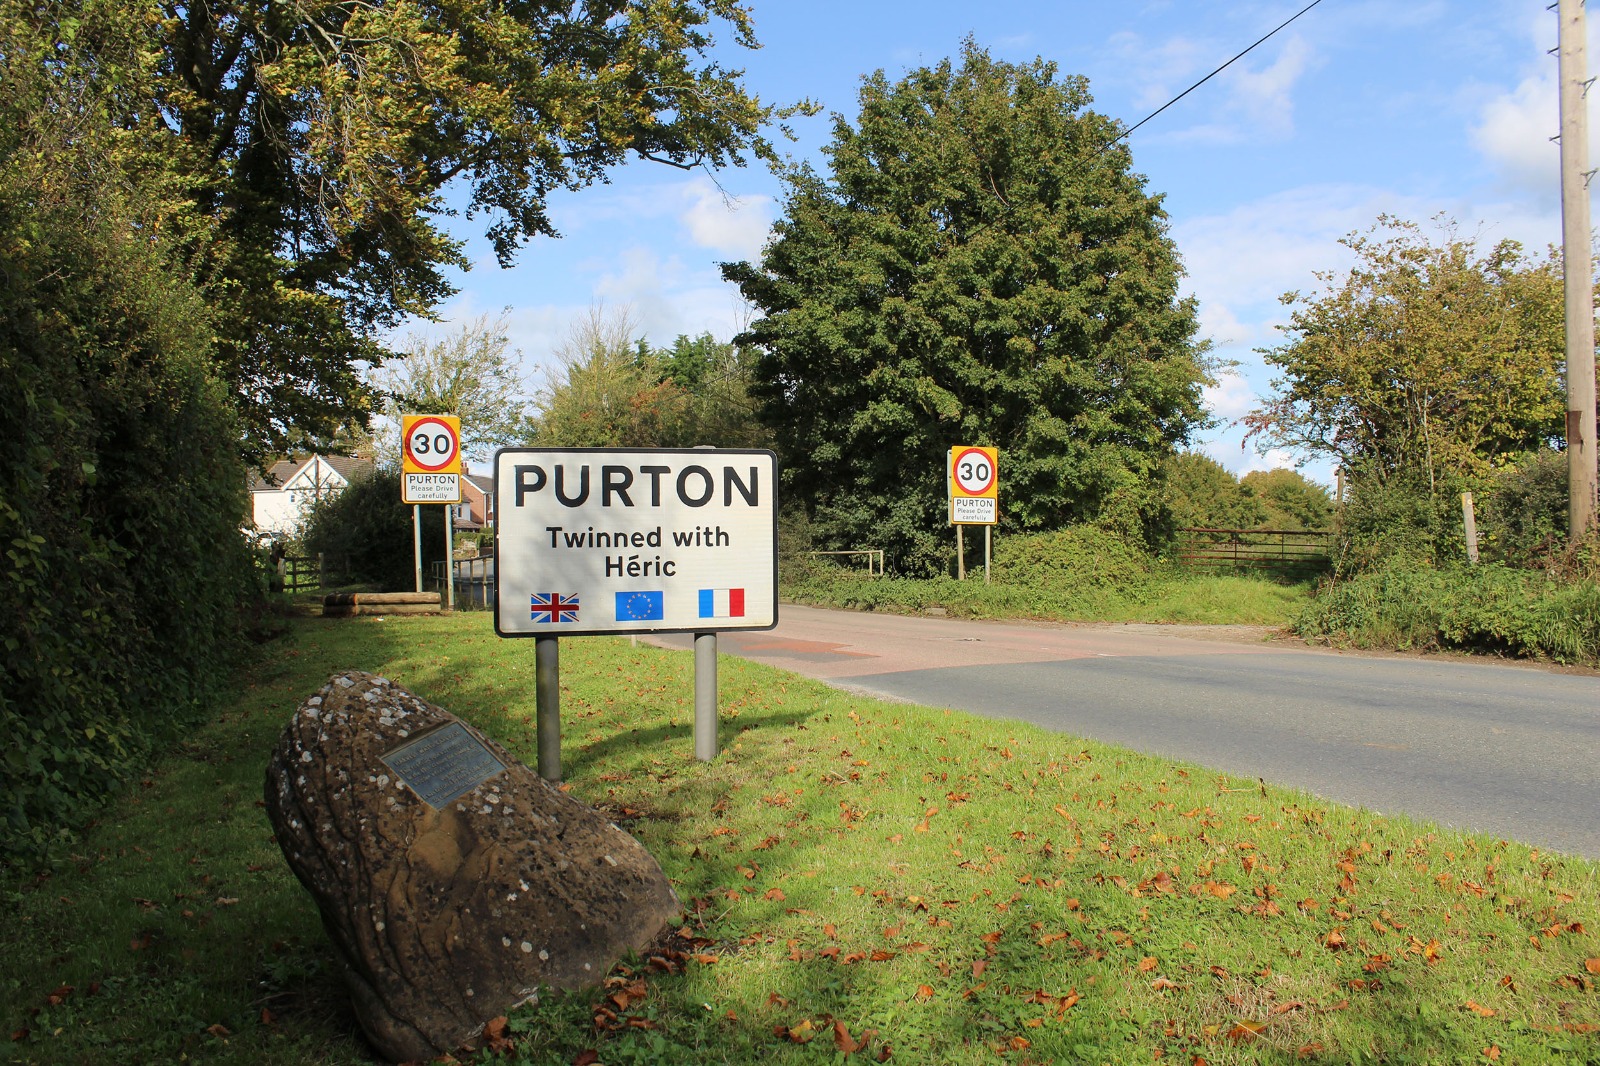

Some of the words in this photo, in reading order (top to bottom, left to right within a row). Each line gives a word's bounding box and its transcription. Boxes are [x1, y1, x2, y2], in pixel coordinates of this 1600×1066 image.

[414, 433, 450, 455] 30
[409, 475, 455, 484] PURTON
[960, 462, 989, 482] 30
[514, 464, 759, 508] PURTON
[956, 499, 993, 508] PURTON
[545, 526, 662, 549] Twinned
[672, 525, 730, 547] with
[605, 554, 677, 577] Héric
